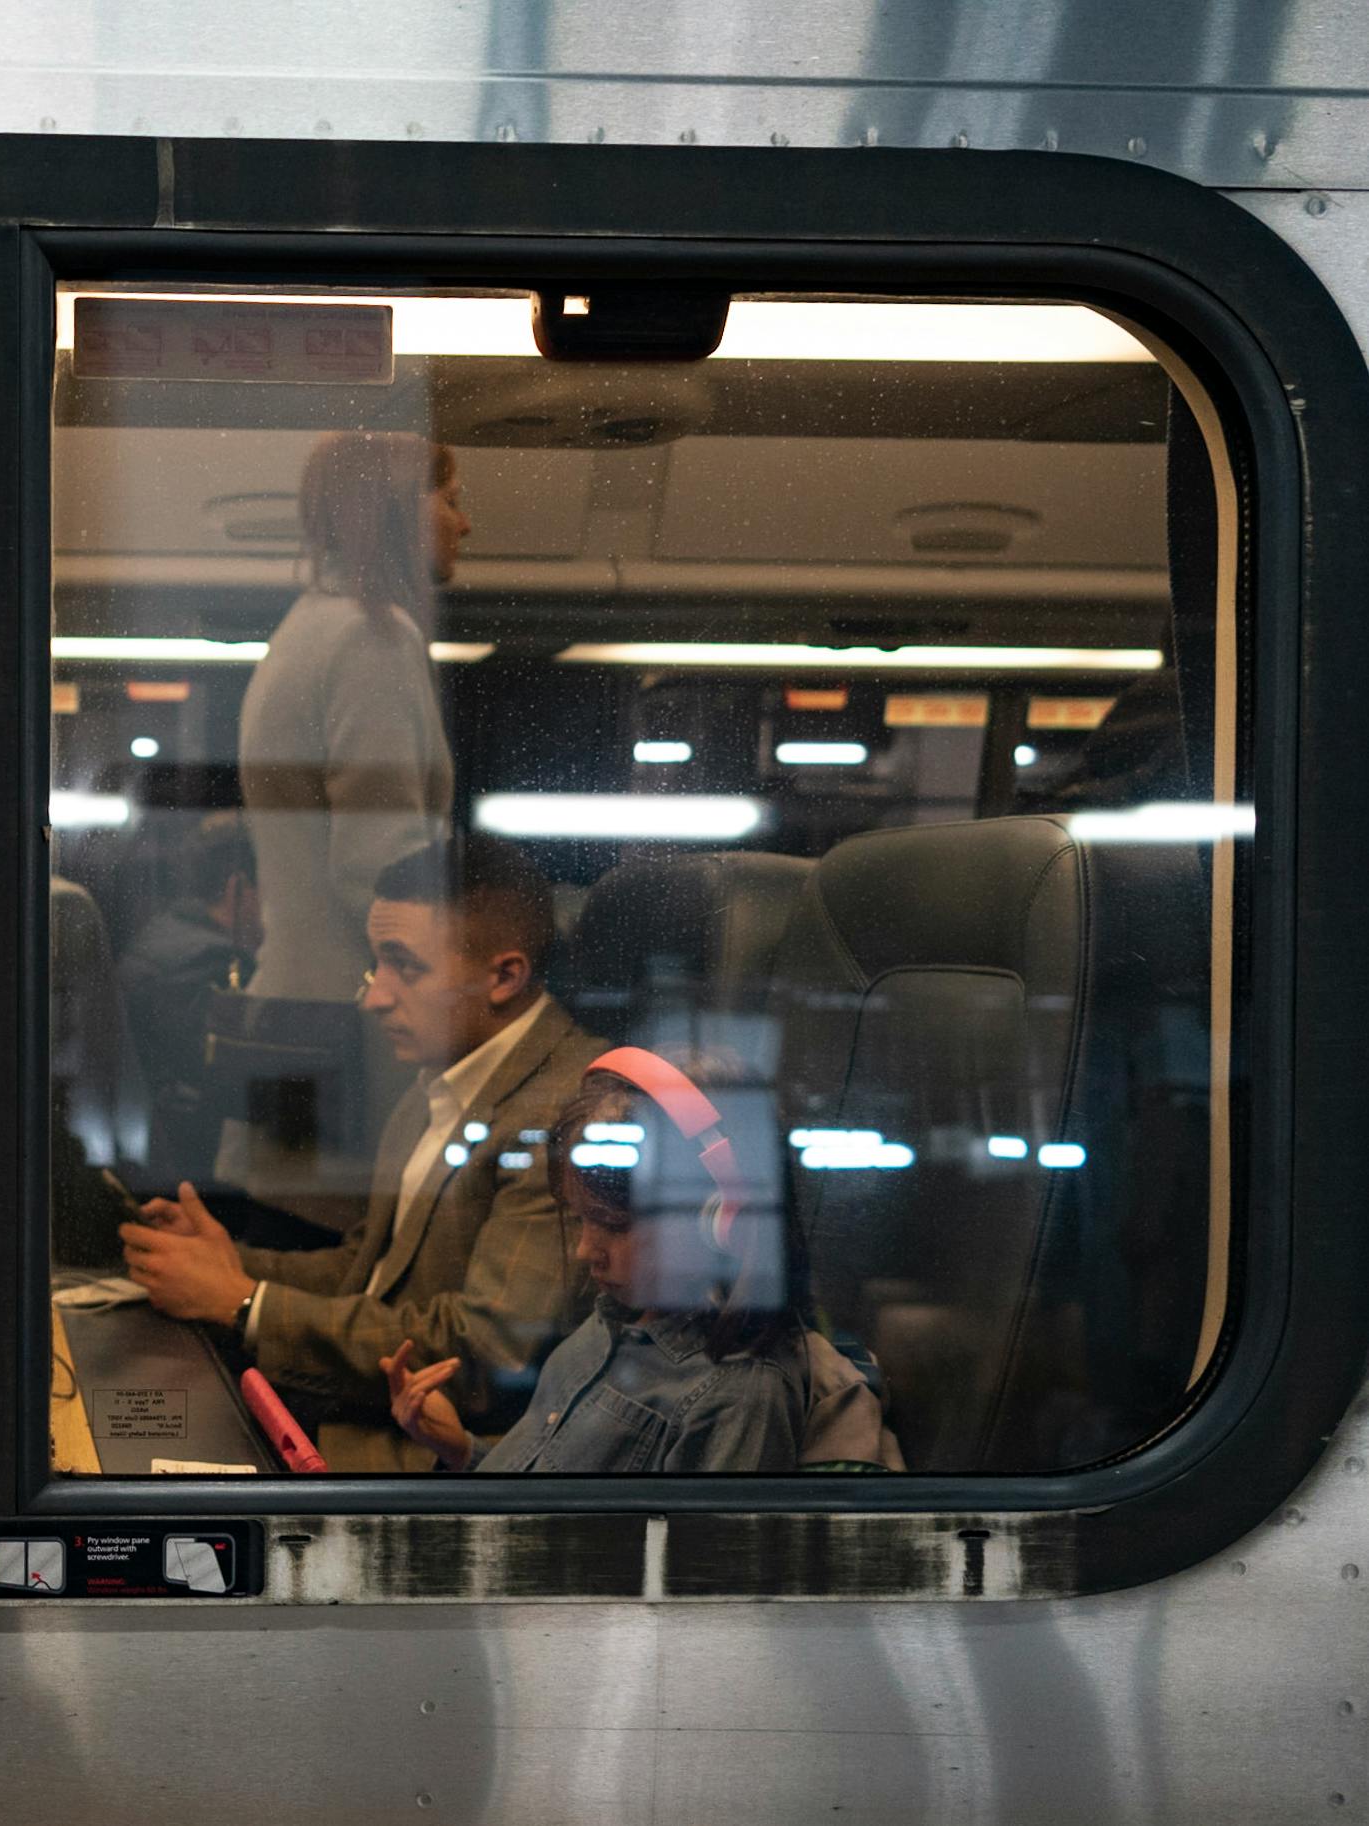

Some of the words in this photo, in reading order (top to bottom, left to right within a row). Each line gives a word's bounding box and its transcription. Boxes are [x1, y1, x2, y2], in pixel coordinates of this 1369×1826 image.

[87, 1537, 101, 1547] Pry
[102, 1537, 131, 1545] window
[132, 1538, 151, 1547] pane
[87, 1553, 129, 1561] screwdriver.
